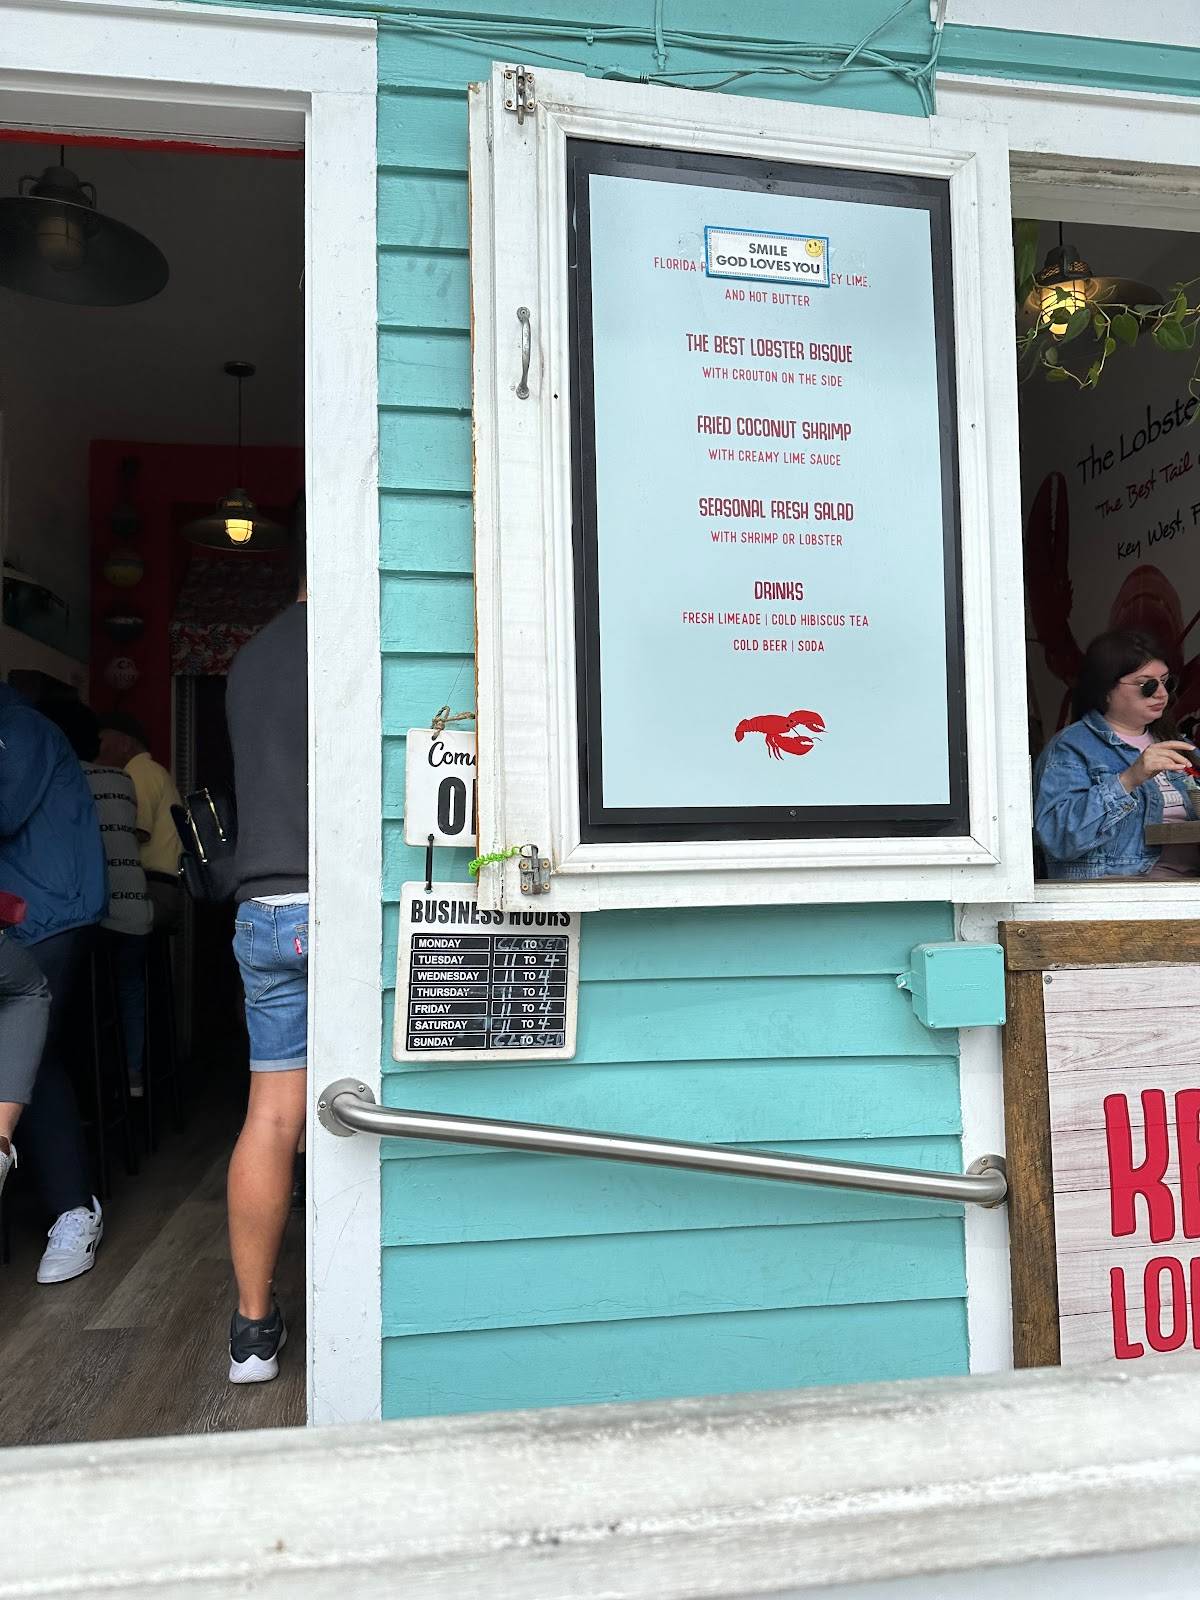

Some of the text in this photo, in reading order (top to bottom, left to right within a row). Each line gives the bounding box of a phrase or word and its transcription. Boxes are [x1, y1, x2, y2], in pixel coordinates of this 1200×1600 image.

[748, 242, 788, 257] SMILE
[654, 256, 696, 271] FLORIDA
[830, 272, 842, 285] EY
[716, 256, 748, 268] GOD
[750, 258, 791, 271] LOVES
[794, 262, 820, 274] YOU
[725, 289, 810, 306] AND HOT BUTTER
[686, 333, 852, 363] THE BEST LOBSTER BISQUE
[702, 367, 843, 387] WITH CROUTON ON THE SIDE
[697, 415, 852, 441] FRIED COCONUT SHRIMP
[708, 448, 842, 466] WITH CREAMY LIME SAUCE
[1077, 445, 1114, 485] The
[1095, 497, 1122, 518] The
[1126, 471, 1156, 509] Best
[1159, 451, 1194, 485] Tail
[699, 498, 854, 522] SEASONAL FRESH SALAD
[710, 531, 843, 546] WITH SHRIMP OR LOBSTER
[1116, 540, 1141, 560] Key
[754, 581, 804, 600] DRINKS
[682, 612, 869, 627] FRESH LIMEADE COLD HIBISCUS TEA
[733, 640, 824, 652] COLD BEER SODA
[411, 900, 571, 927] BUSINESS HOURS
[418, 939, 461, 948] MONDAY
[418, 956, 464, 964] TUESDAY
[524, 956, 537, 964] TO
[544, 954, 560, 967] 4
[417, 971, 479, 981] WEDNESDAY
[523, 972, 536, 980] TO
[538, 970, 550, 985] 4
[417, 988, 470, 997] THURSDAY
[523, 988, 535, 996] TO
[415, 1004, 451, 1015] FRIDAY
[522, 1004, 534, 1012] TO
[415, 1020, 468, 1029] SATURDAY
[521, 1020, 534, 1028] TO
[413, 1037, 455, 1046] SUNDAY
[1109, 1256, 1200, 1360] LO
